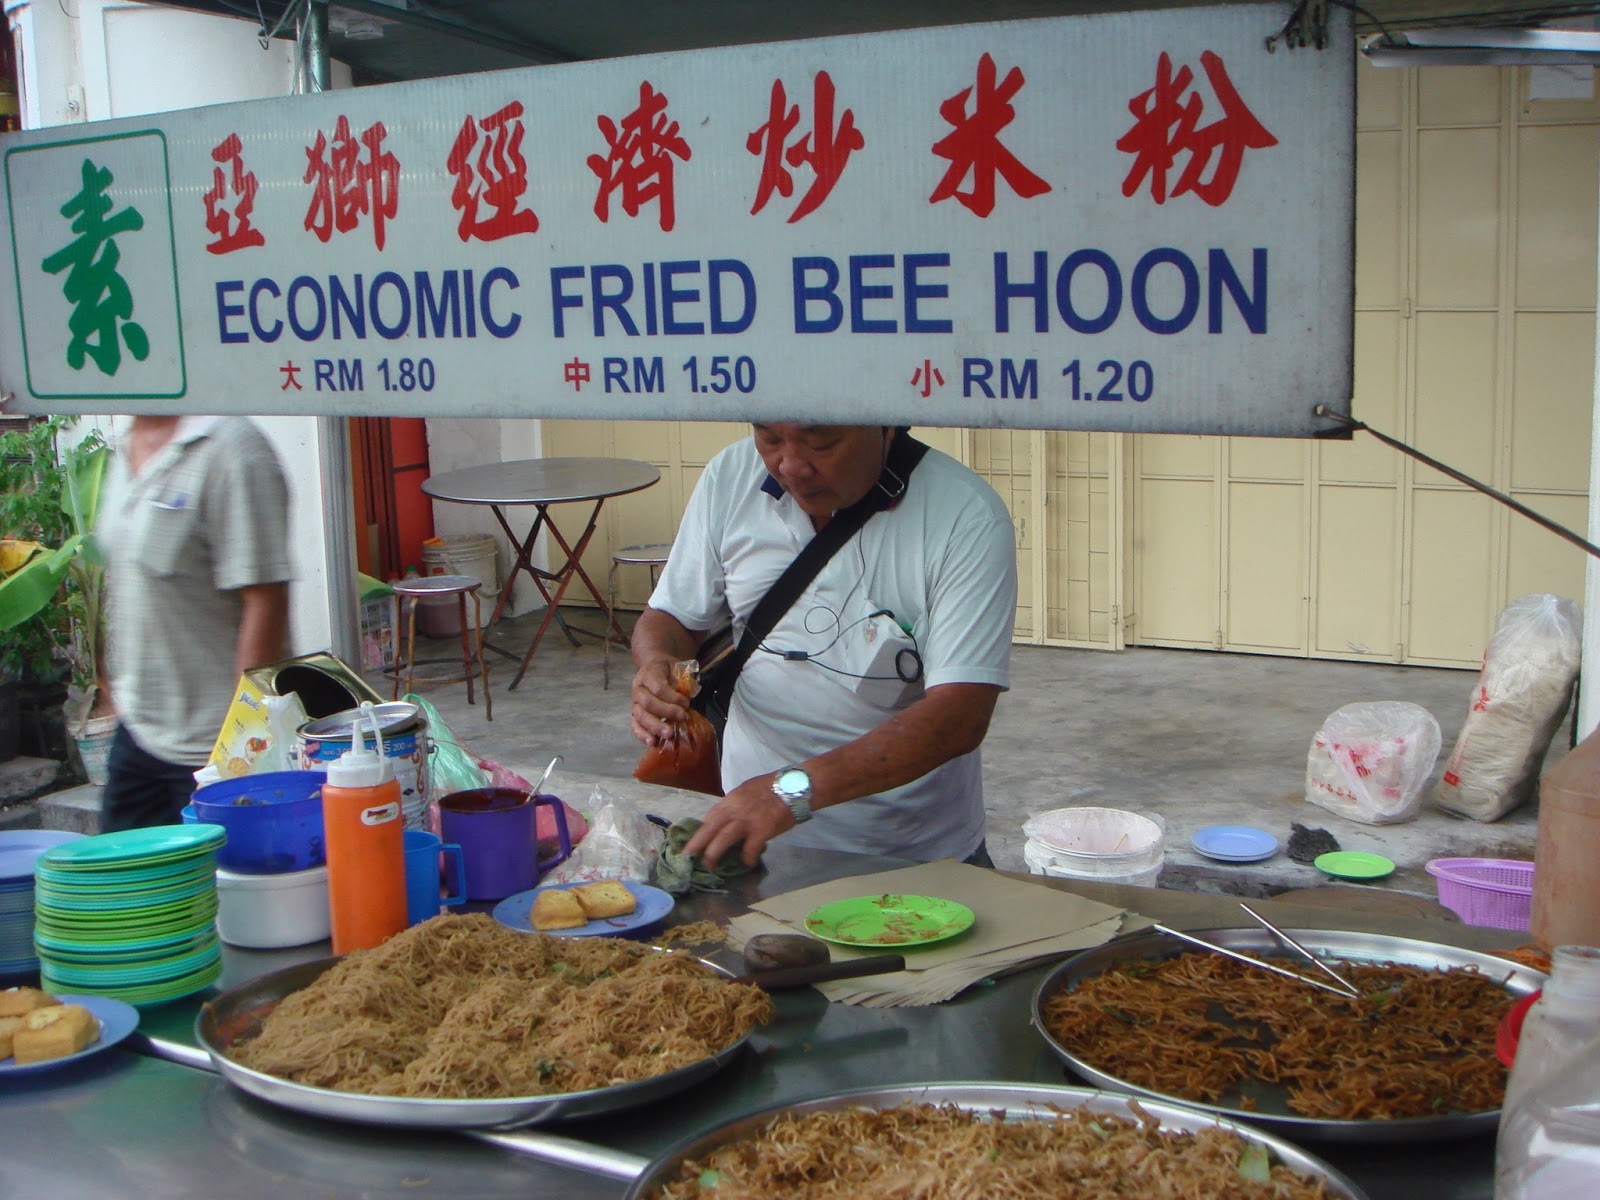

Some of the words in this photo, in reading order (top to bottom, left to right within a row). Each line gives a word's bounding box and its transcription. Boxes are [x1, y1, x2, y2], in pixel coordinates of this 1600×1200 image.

[42, 158, 149, 377] 素
[216, 266, 522, 344] ECONOMIC
[550, 259, 757, 337] FRIED
[793, 252, 953, 334] BEE
[993, 246, 1267, 334] HOON
[280, 361, 303, 392] 大
[315, 358, 363, 391] RM
[378, 357, 435, 392] 1.80
[564, 356, 591, 393] 中
[603, 356, 665, 393] RM
[682, 355, 757, 393] 1.50
[911, 358, 944, 398] 小
[963, 357, 1038, 399] RM
[1062, 358, 1154, 402] 1.20
